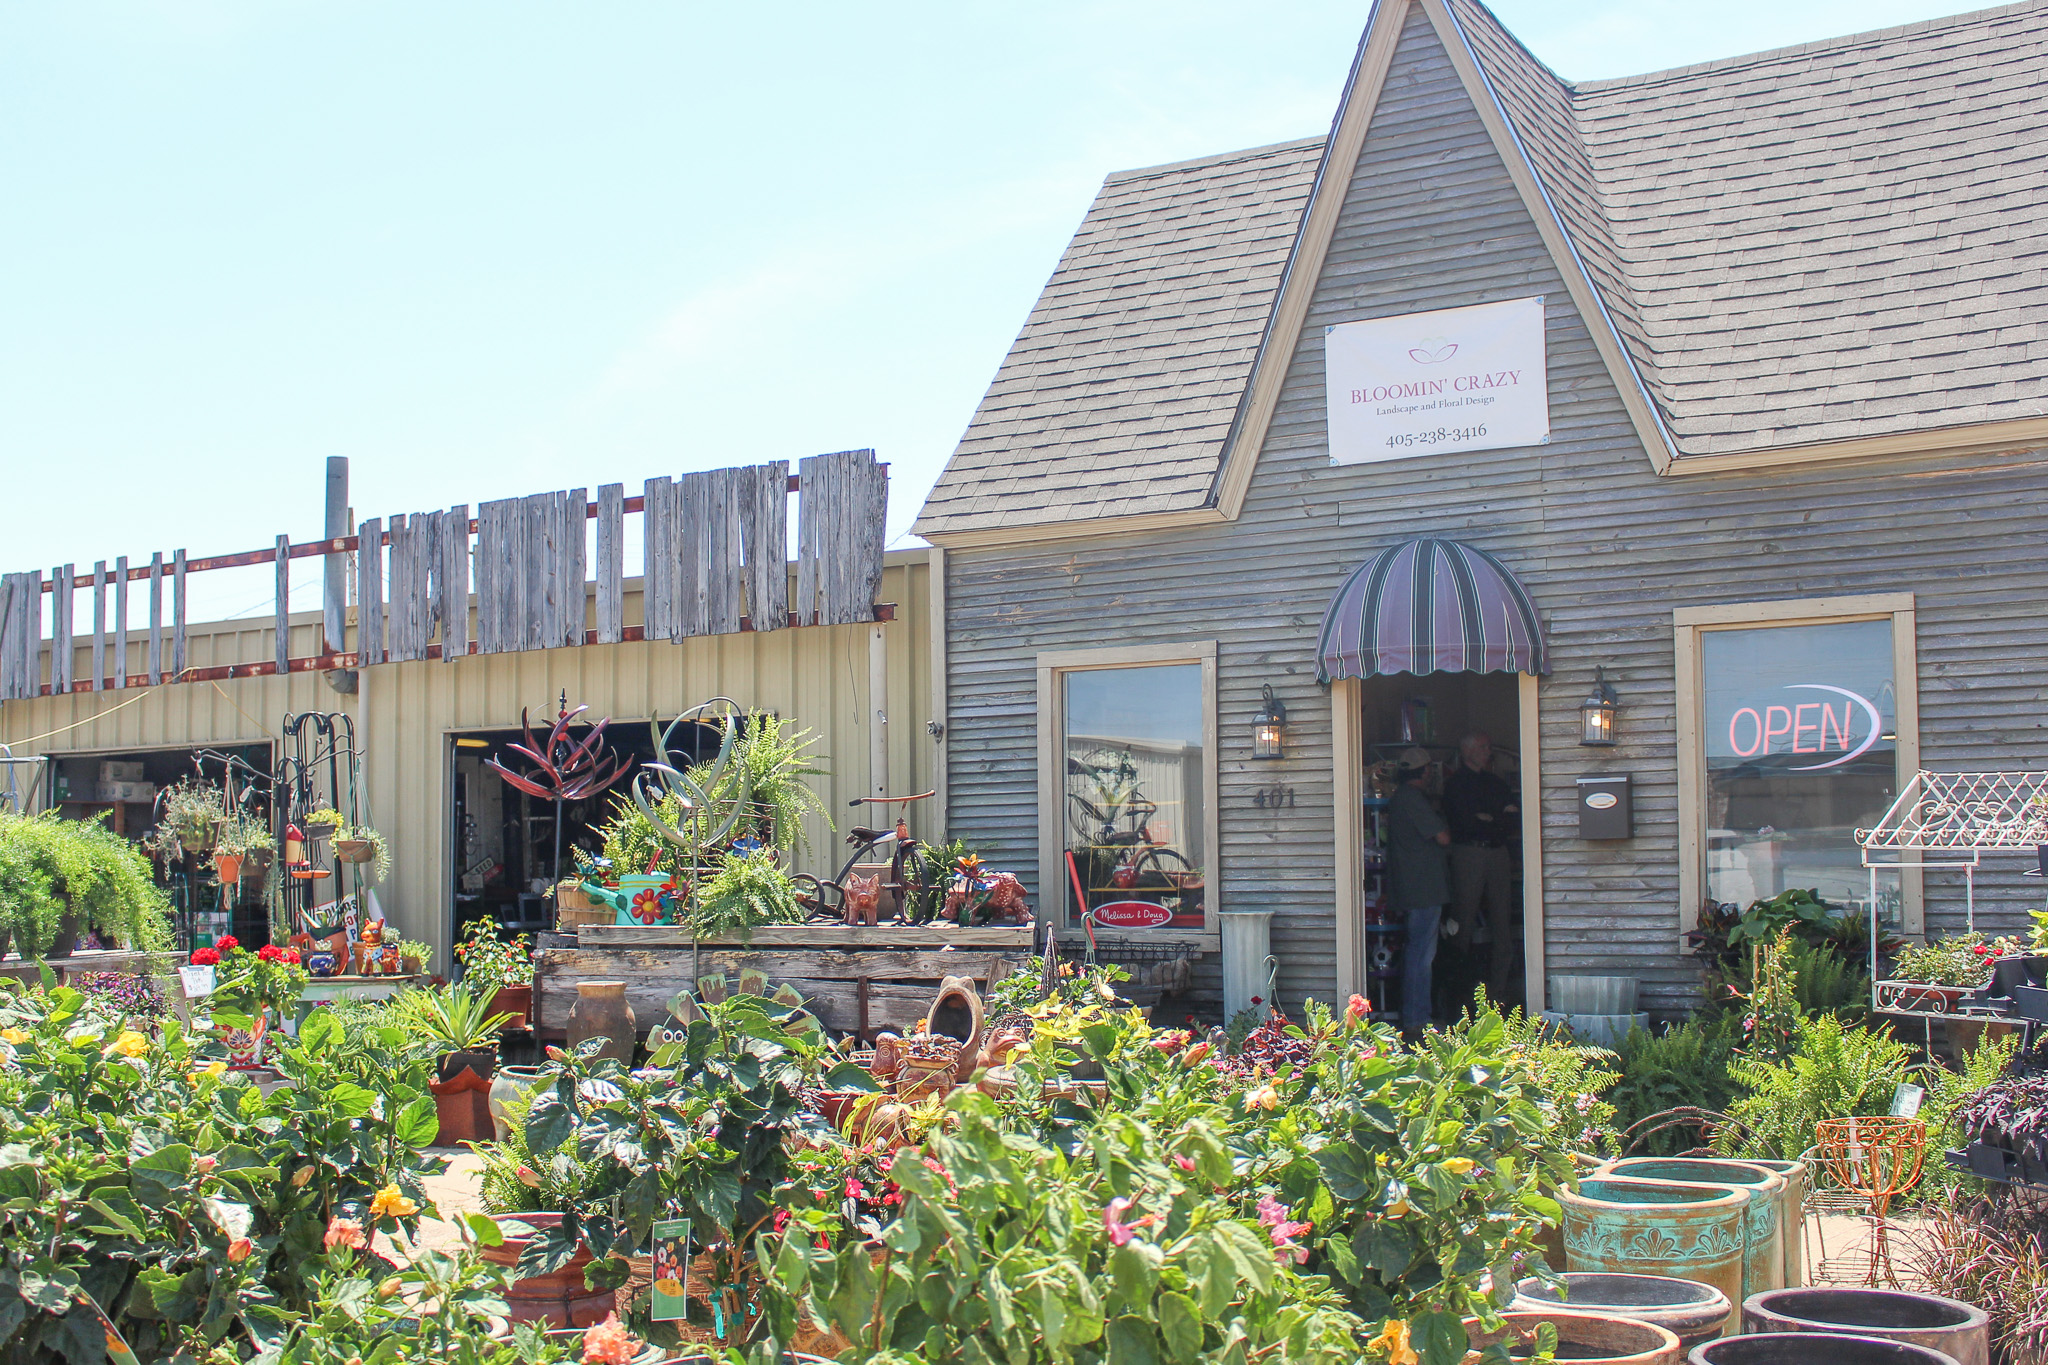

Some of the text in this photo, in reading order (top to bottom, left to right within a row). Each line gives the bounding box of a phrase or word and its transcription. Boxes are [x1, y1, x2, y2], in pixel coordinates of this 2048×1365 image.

[1351, 370, 1522, 404] BLOOMIN' CRAZY
[1376, 395, 1495, 416] Landscape and Floral Design
[1385, 423, 1487, 448] 405-238-3416
[1730, 701, 1851, 757] OPEN
[1253, 788, 1294, 808] 401
[1100, 909, 1134, 921] Melissa
[1143, 910, 1163, 923] Doug
